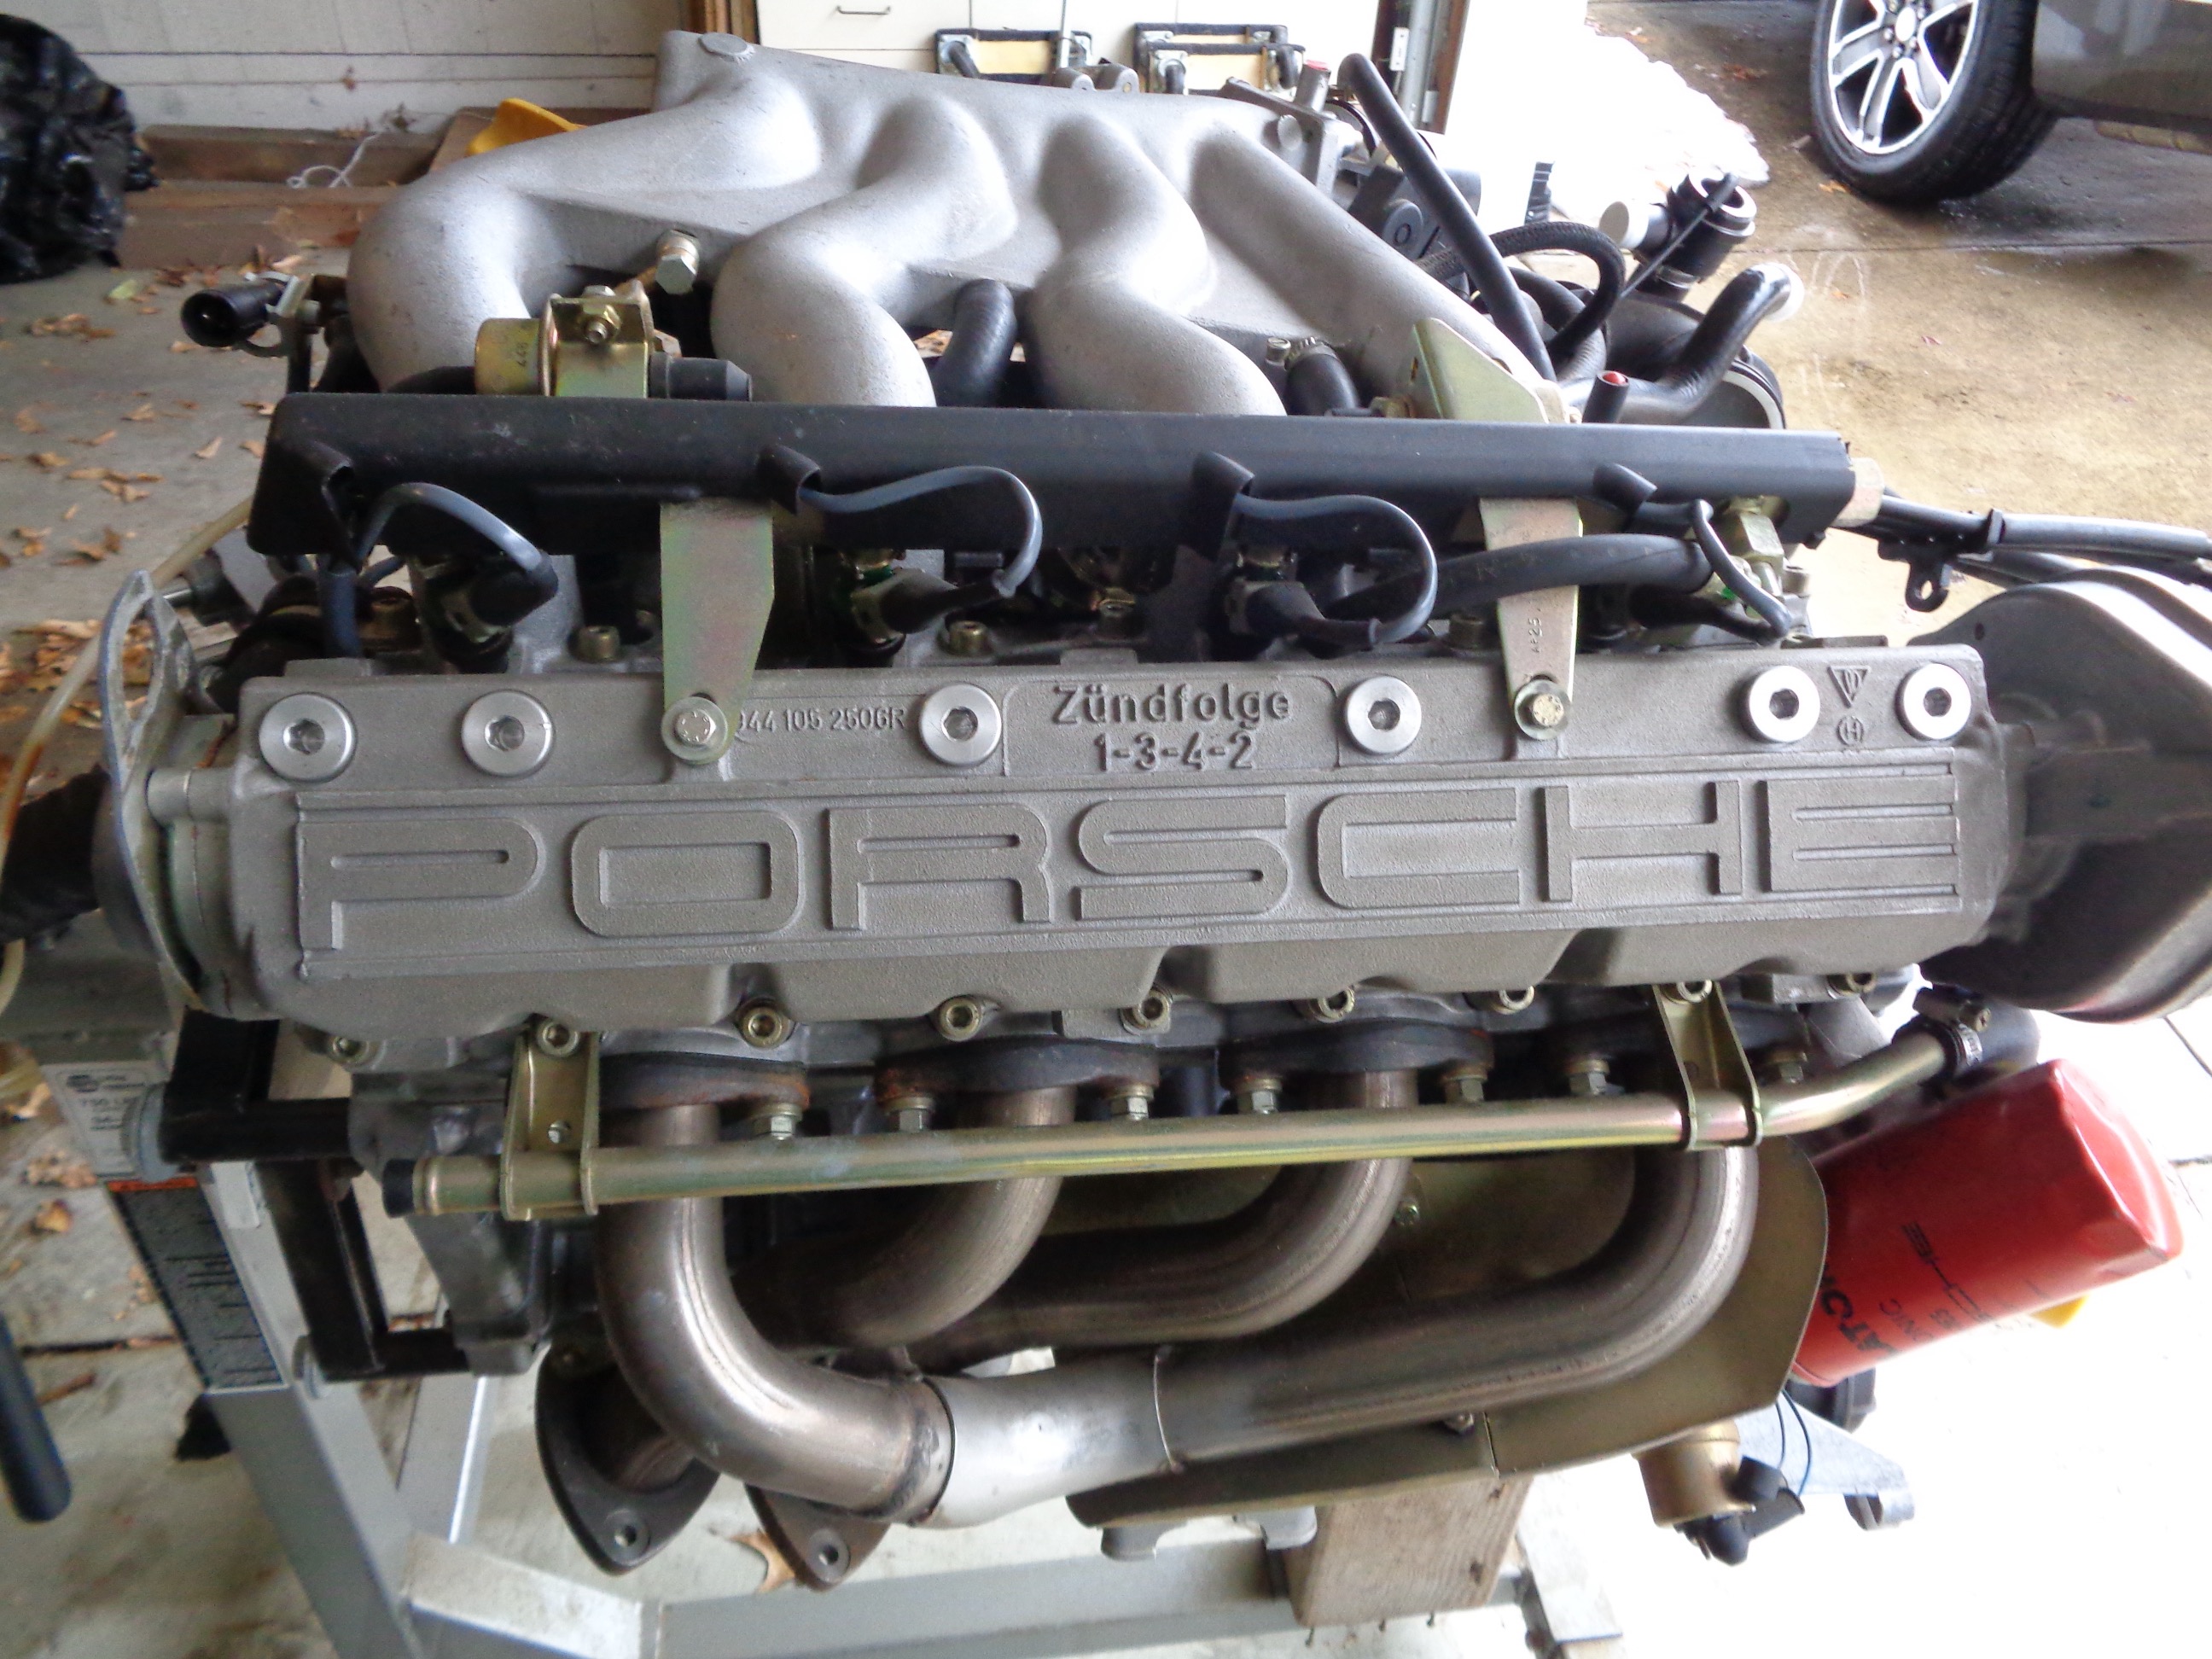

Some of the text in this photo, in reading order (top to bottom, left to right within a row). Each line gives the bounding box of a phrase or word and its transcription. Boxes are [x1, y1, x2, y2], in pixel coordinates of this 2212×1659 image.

[783, 707, 823, 732] 105
[830, 704, 906, 731] 2506R
[1052, 682, 1293, 731] Zündfolge
[1093, 731, 1255, 772] 1-3-4-2
[299, 775, 1957, 950] PORSCHE
